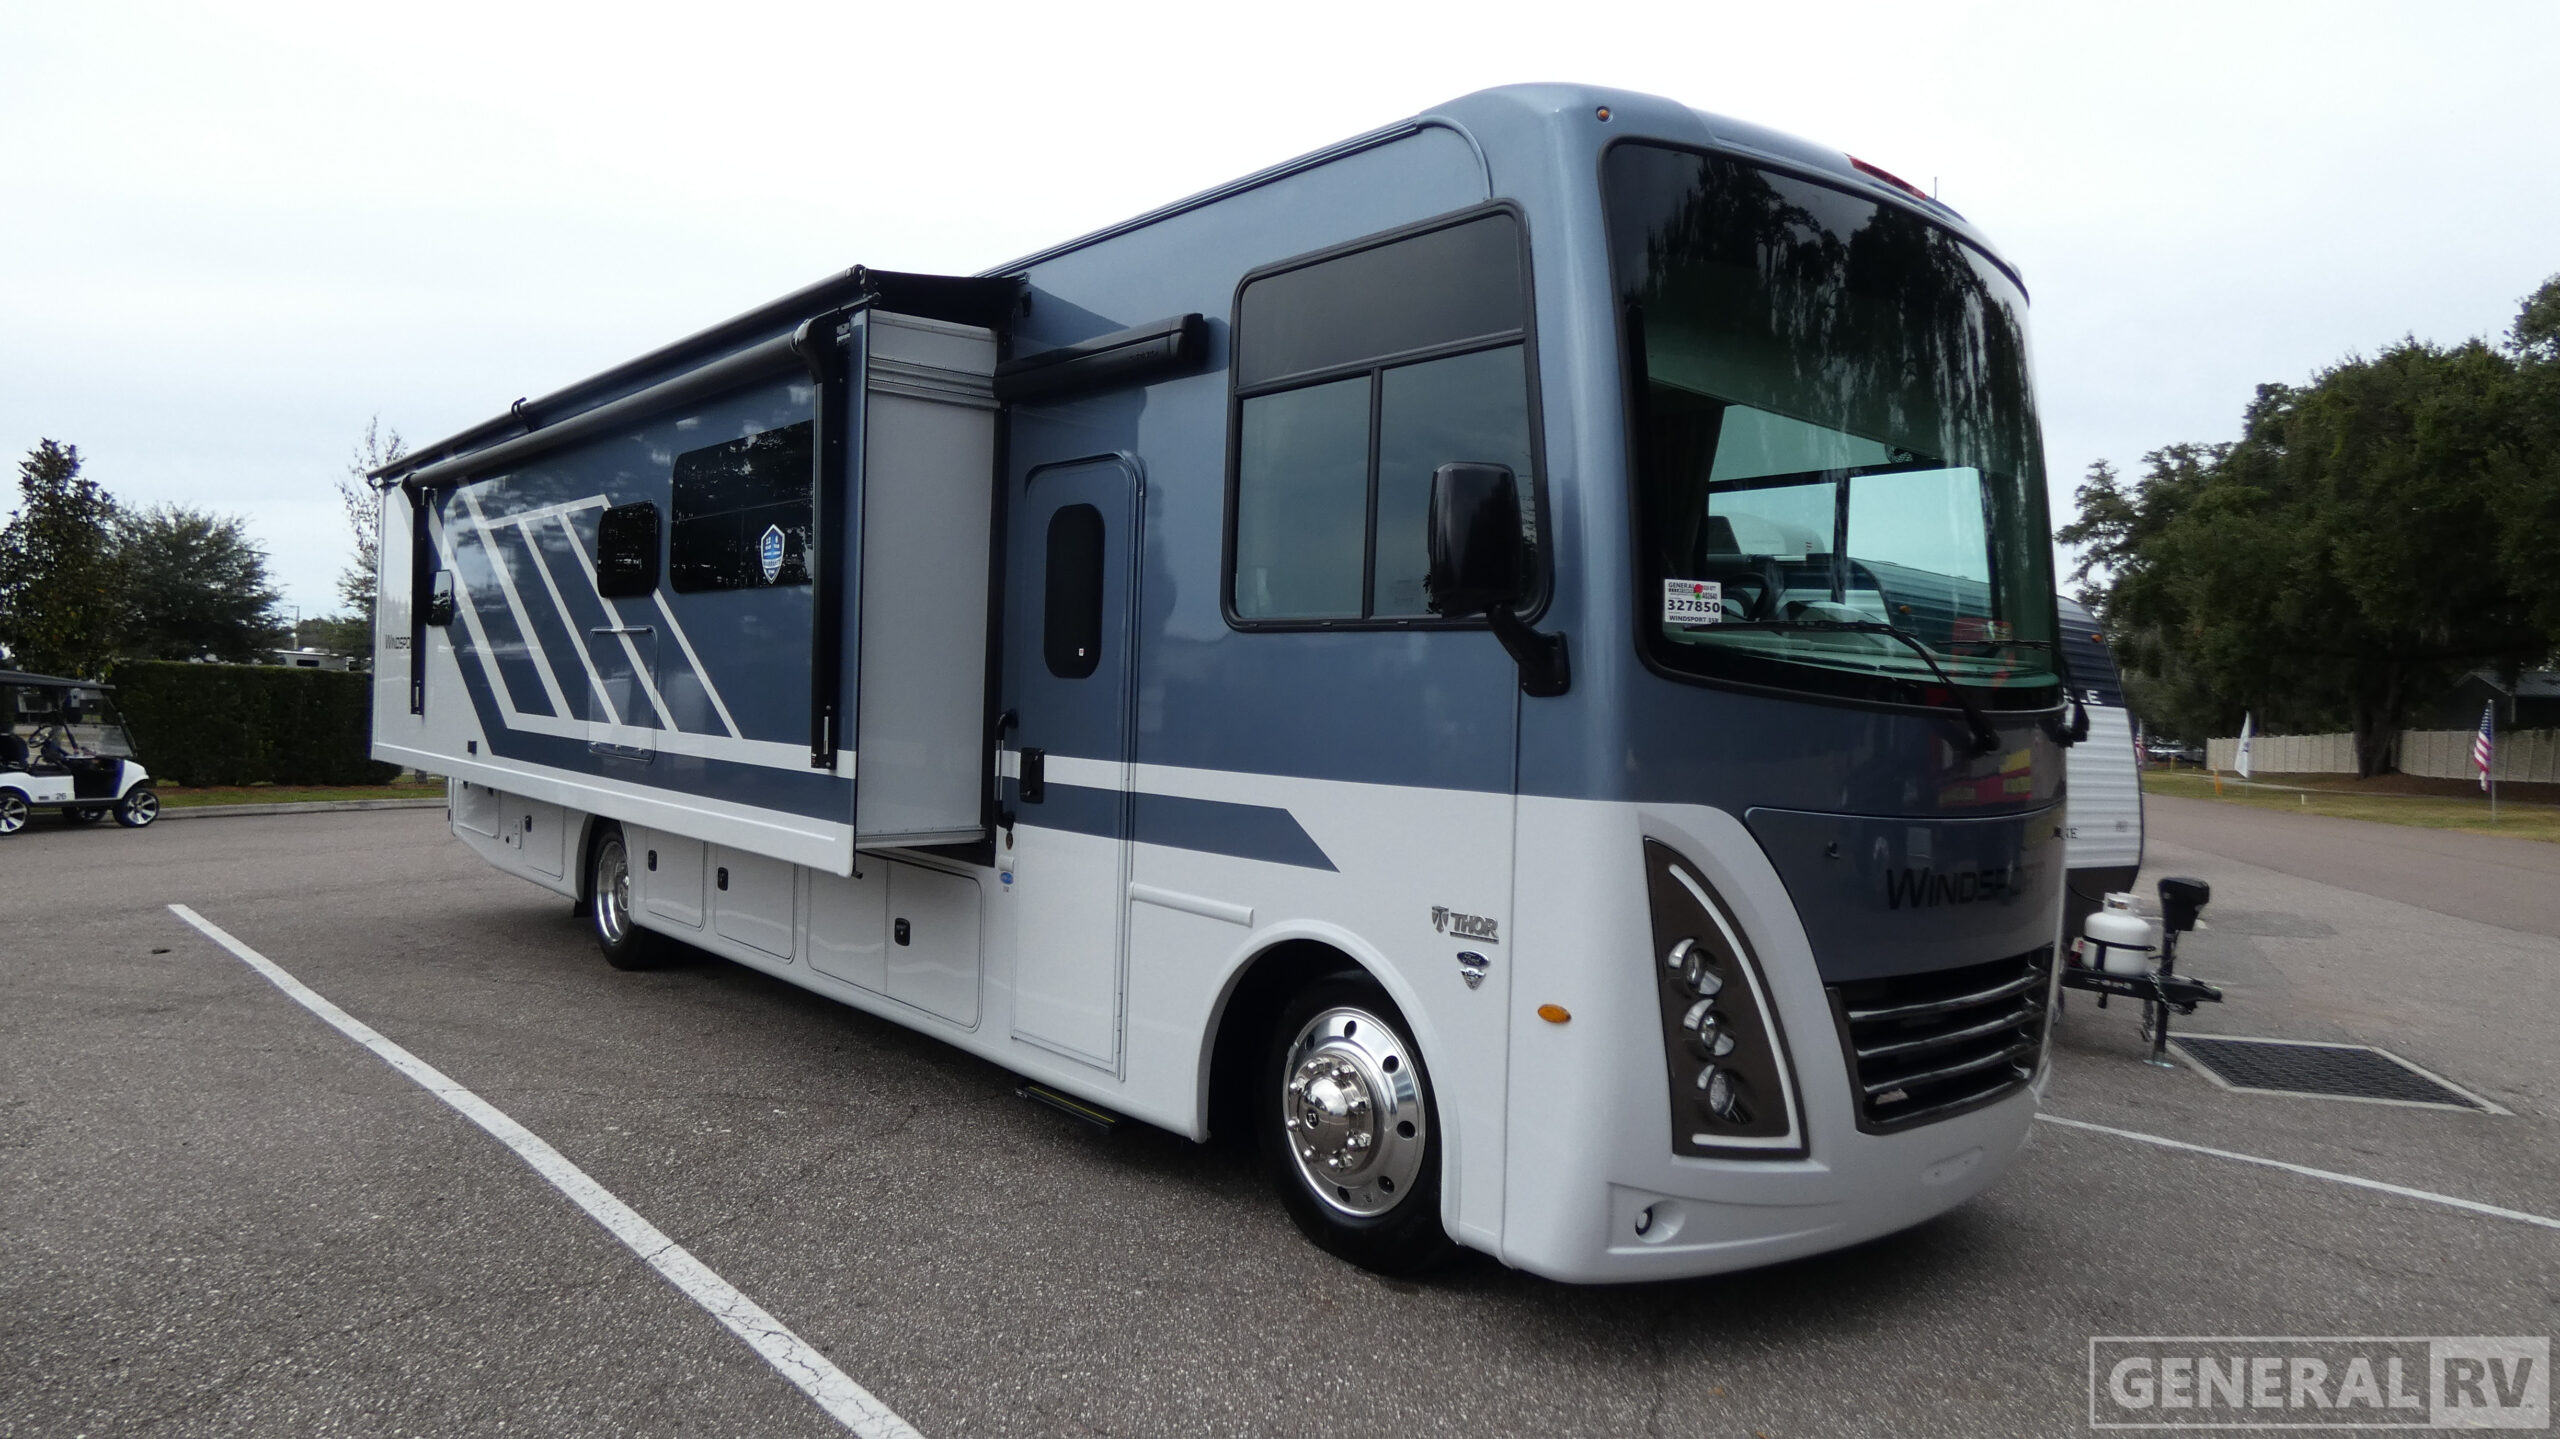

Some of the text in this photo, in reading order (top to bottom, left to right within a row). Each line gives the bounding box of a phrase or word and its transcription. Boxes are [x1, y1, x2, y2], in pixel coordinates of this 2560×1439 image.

[1668, 600, 1720, 613] 327850
[1886, 862, 2044, 910] WINDSP
[1450, 912, 1499, 938] THOR
